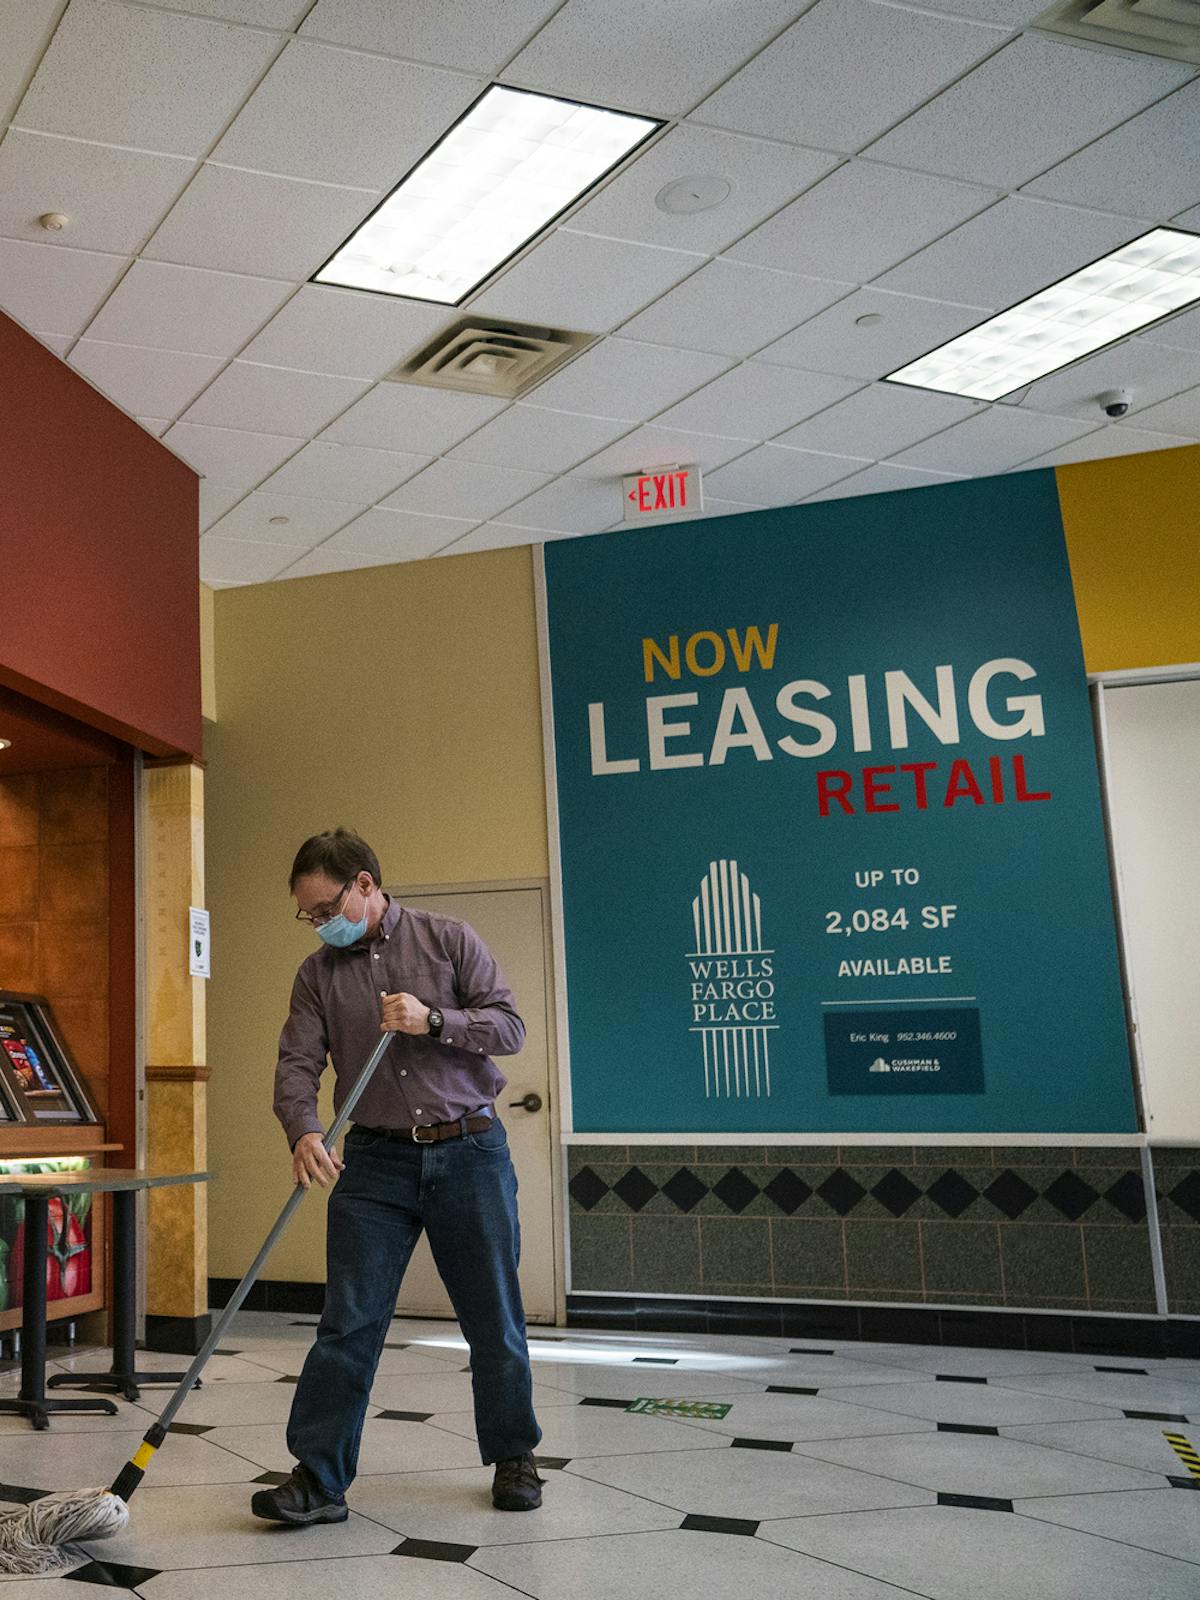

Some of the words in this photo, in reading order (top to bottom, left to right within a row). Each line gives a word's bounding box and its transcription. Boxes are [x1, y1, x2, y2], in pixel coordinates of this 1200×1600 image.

[638, 471, 689, 512] EXIT
[642, 623, 779, 683] NOW
[588, 657, 1046, 776] LEASING
[816, 754, 1052, 817] RETAIL
[854, 870, 884, 889] UP
[891, 867, 920, 886] TO
[825, 906, 909, 937] 2,084
[920, 905, 958, 930] SF
[689, 958, 774, 980] WELLS
[838, 956, 953, 977] AVAILABLE
[690, 980, 775, 1001] FARGO
[692, 1001, 777, 1022] PLACE
[849, 1032, 867, 1043] Eric
[869, 1032, 890, 1044] King
[896, 1031, 957, 1042] 952.346.4600
[891, 1058, 932, 1066] CUSHMAN
